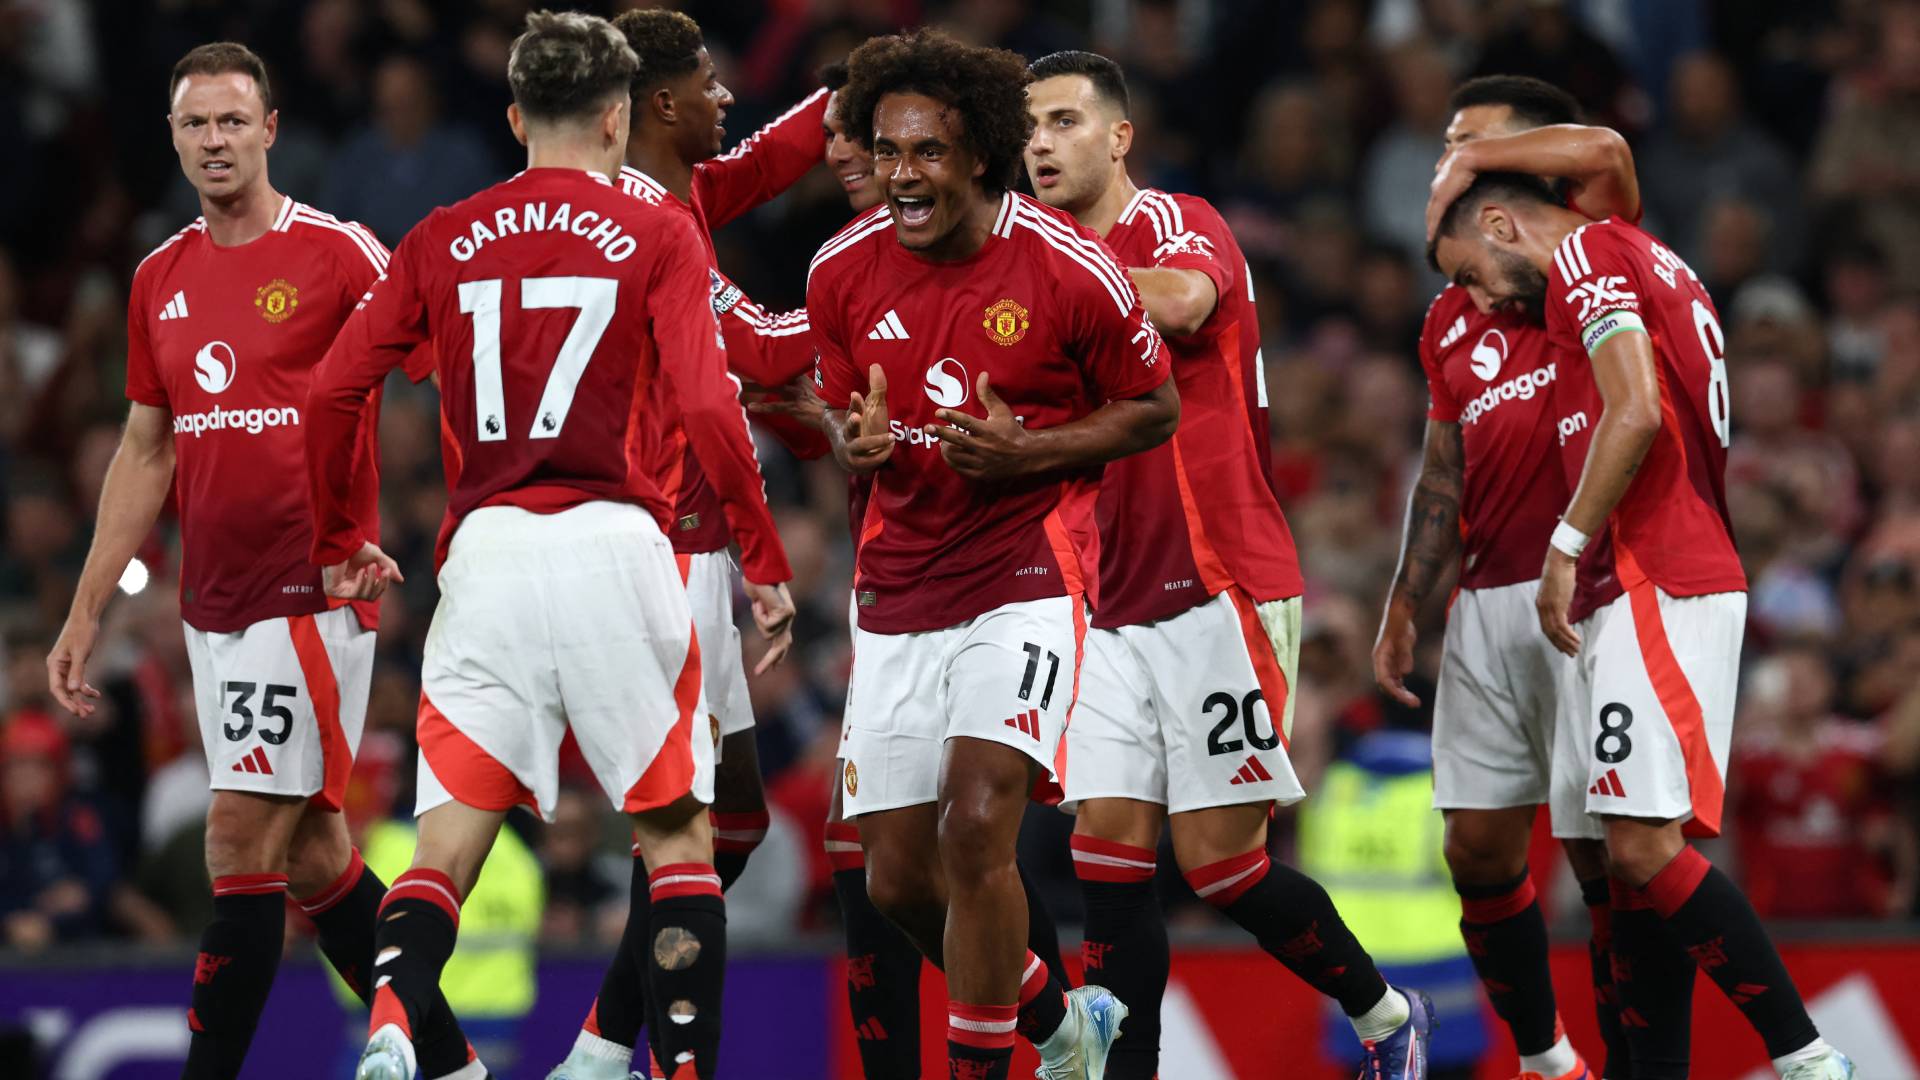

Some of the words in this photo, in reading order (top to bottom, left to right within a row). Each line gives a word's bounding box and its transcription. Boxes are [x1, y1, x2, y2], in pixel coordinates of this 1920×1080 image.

[450, 202, 637, 263] GARNACHO
[457, 276, 619, 442] 17
[1585, 318, 1619, 350] ptain
[1458, 362, 1557, 425] pdrago
[1691, 299, 1730, 448] 8
[173, 404, 299, 438] napdragon
[1018, 641, 1060, 711] 11
[220, 680, 297, 745] 35
[1202, 688, 1280, 756] 20
[1595, 702, 1633, 763] 8
